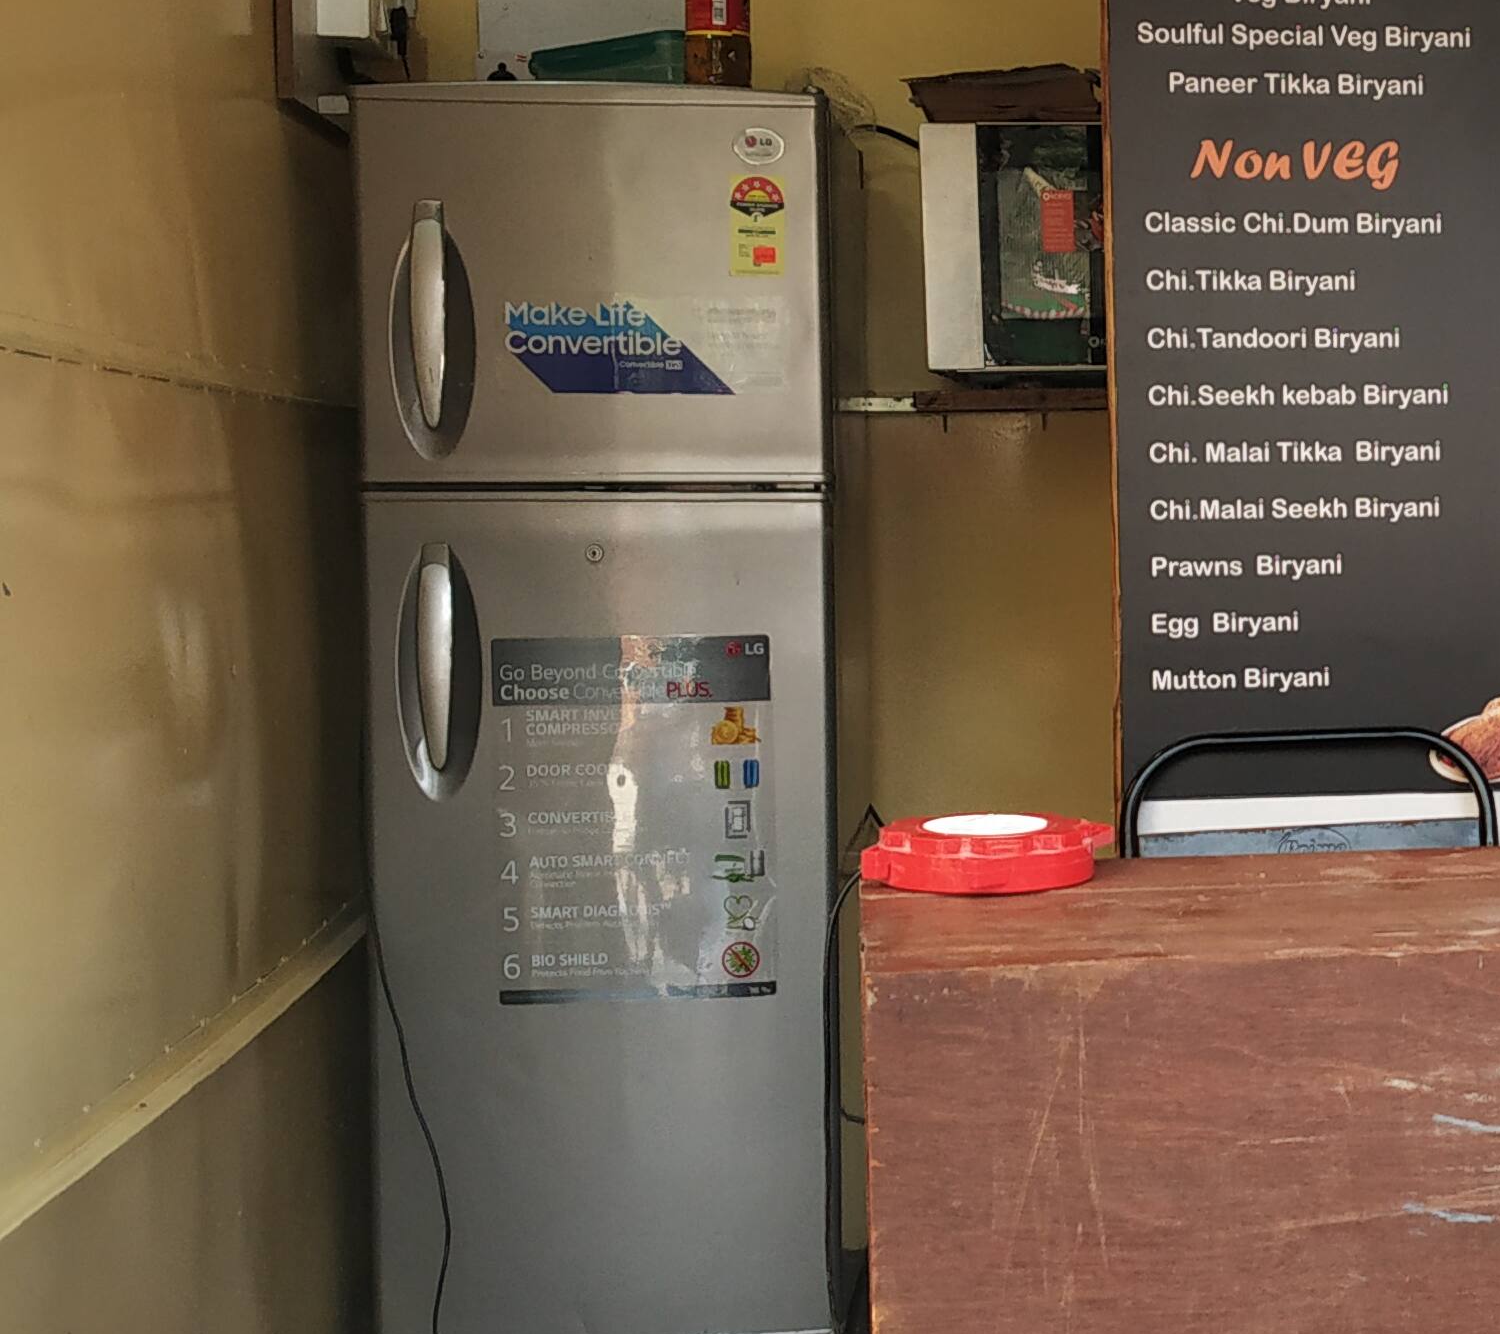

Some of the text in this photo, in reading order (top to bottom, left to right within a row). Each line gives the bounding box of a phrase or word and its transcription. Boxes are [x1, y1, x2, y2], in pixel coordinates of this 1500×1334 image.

[1137, 21, 1471, 53] Soulful Special Veg Biryani
[1169, 71, 1424, 101] Paneer Tikka Biryani
[759, 138, 773, 147] LG
[1190, 139, 1399, 190] Non VEG
[1145, 211, 1442, 239] Classic Chi.Dum Biryani
[1146, 269, 1356, 297] Chi.Tikka Biryani
[504, 300, 647, 327] Make Life
[504, 329, 682, 356] Convertible
[1147, 327, 1400, 354] Chi.Tandoori Biryani
[1148, 384, 1449, 410] Chi.Seekh kebab Biryani
[1149, 440, 1441, 467] Chi. Malai Tikka Biryani
[1150, 496, 1440, 523] Chi.Malai Seekh Biryani
[1151, 553, 1342, 581] Prawns Biryani
[1151, 611, 1299, 639] Egg Biryani
[744, 642, 766, 656] LG
[499, 664, 526, 681] Go
[530, 663, 598, 685] Beyond
[1152, 666, 1330, 693] Mutton Biryani
[499, 683, 570, 701] Choose
[499, 764, 572, 791] 2 DOOR
[499, 812, 517, 838] 3
[500, 859, 520, 885] 4
[528, 854, 569, 869] AUTO
[502, 906, 521, 933] 5
[530, 905, 579, 919] SMART
[502, 953, 522, 980] 6
[530, 953, 557, 967] BIO
[558, 951, 609, 966] SHIELD
